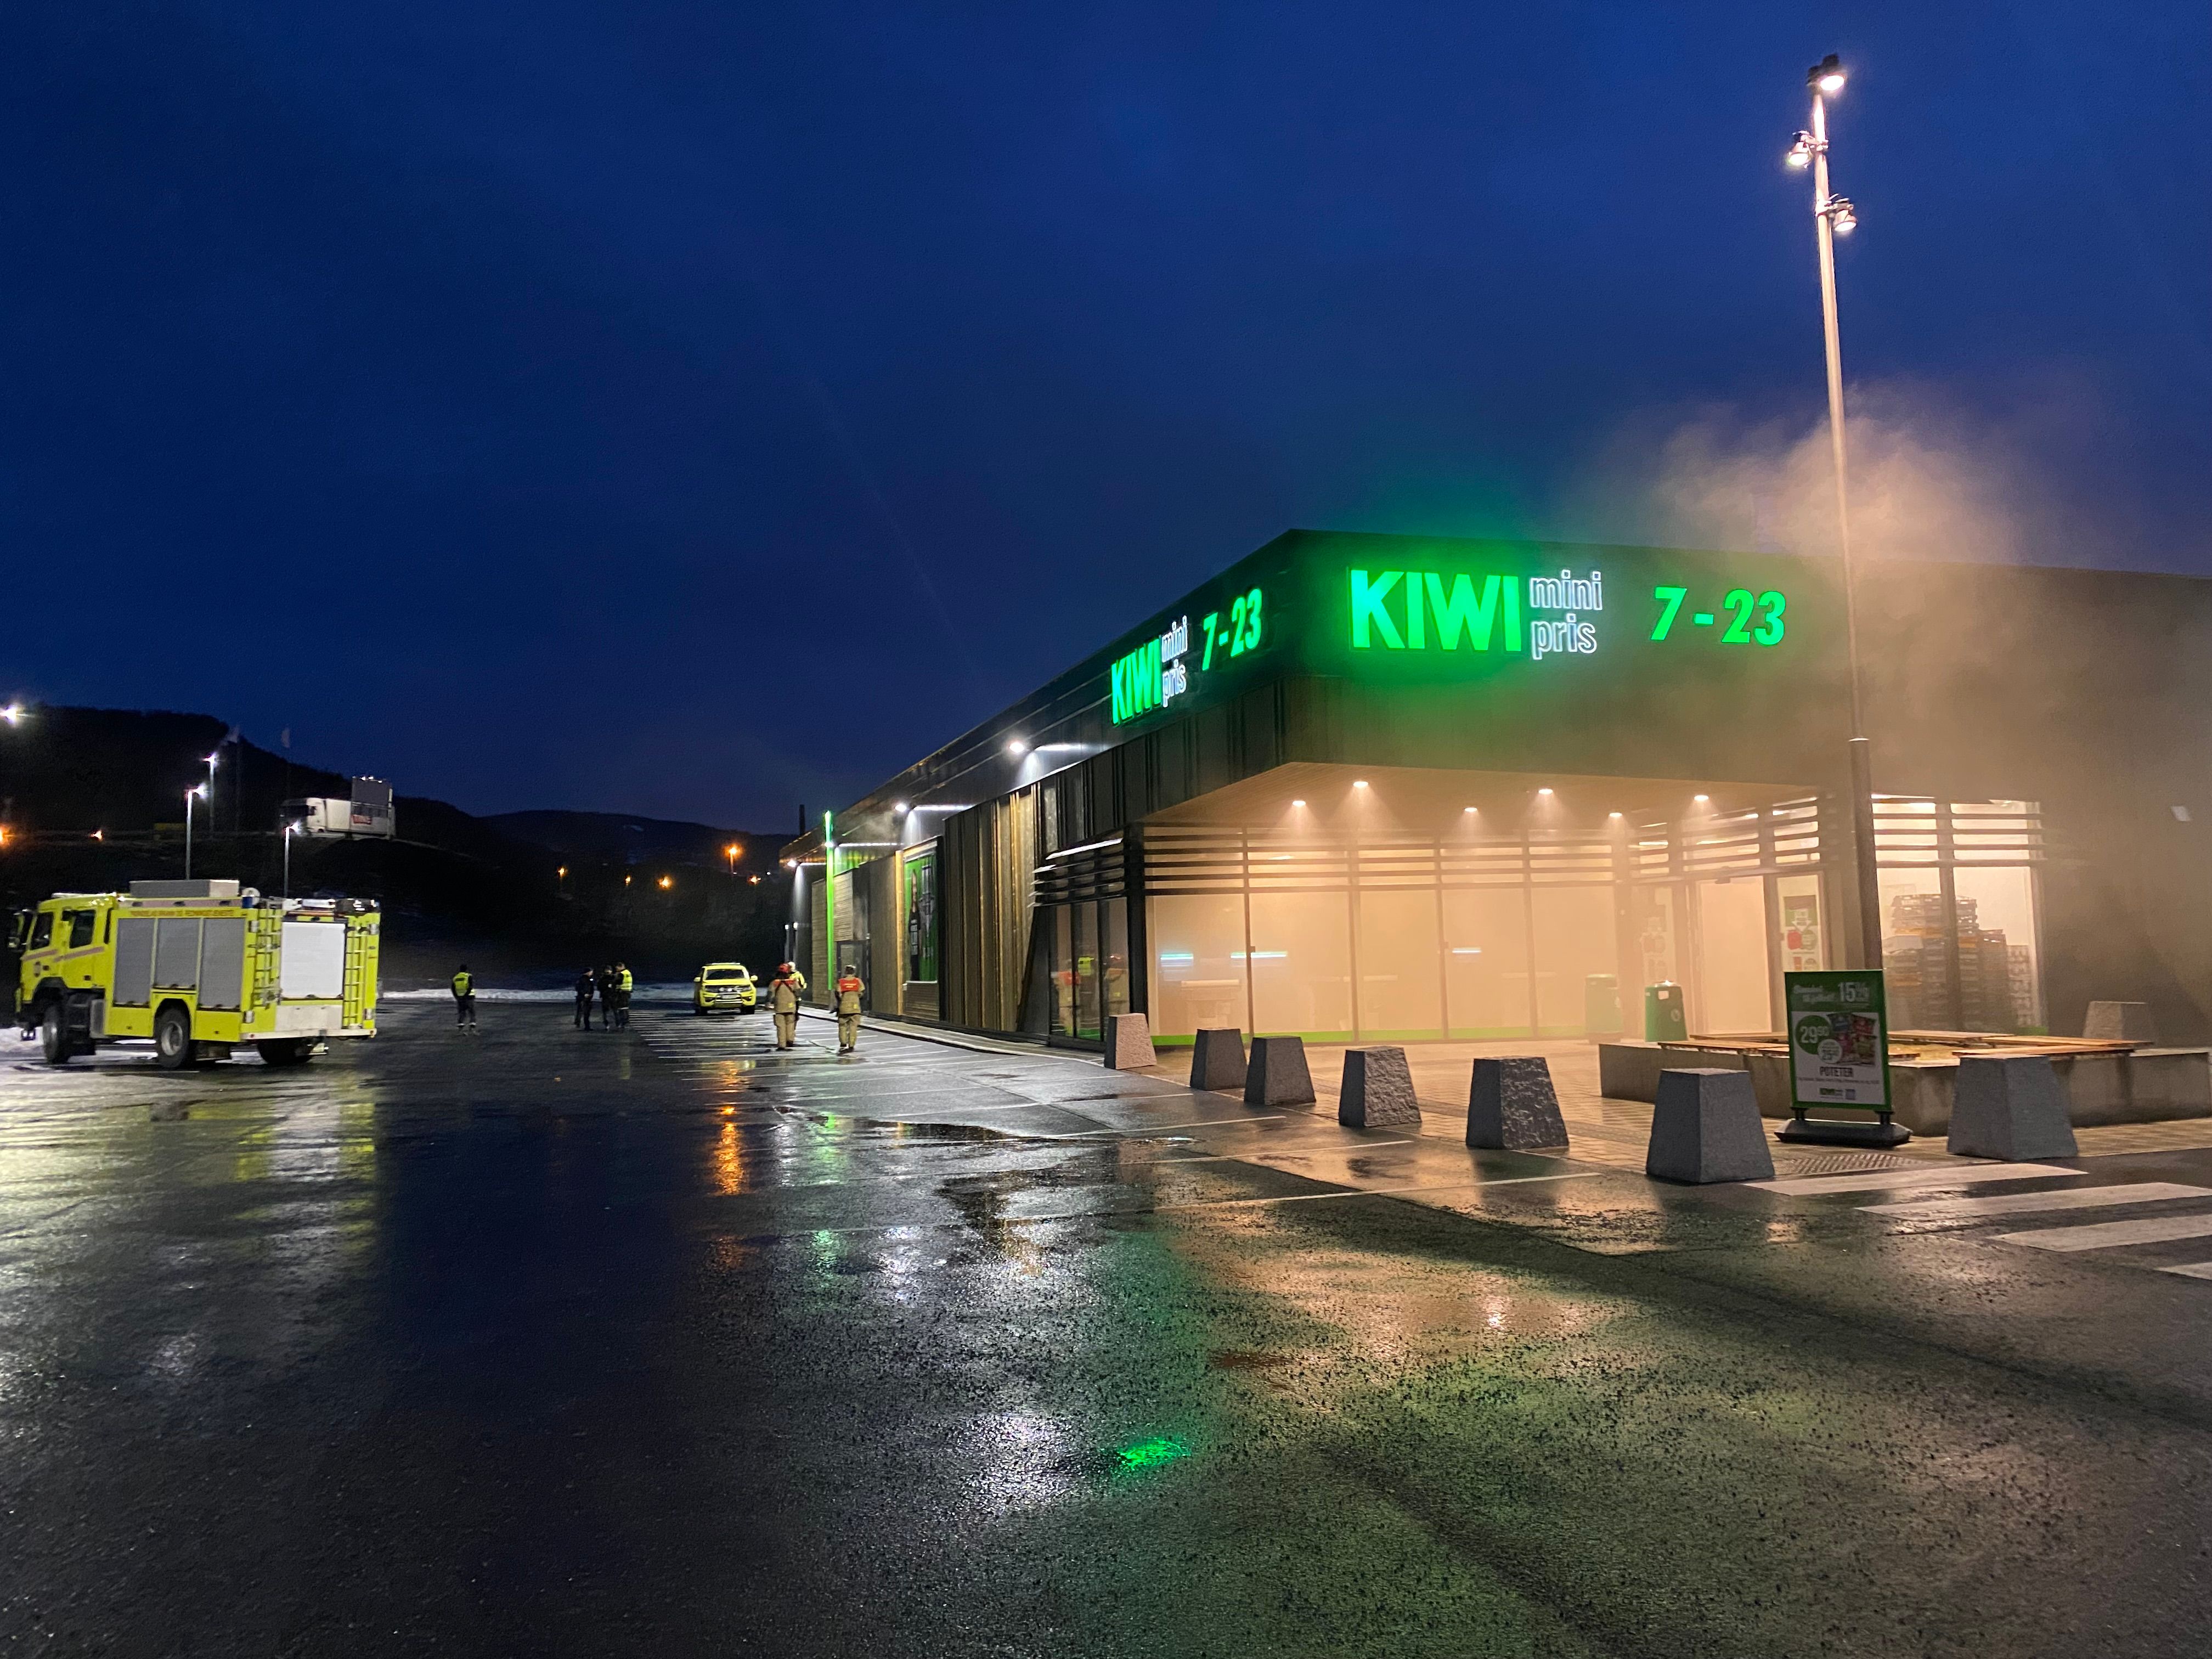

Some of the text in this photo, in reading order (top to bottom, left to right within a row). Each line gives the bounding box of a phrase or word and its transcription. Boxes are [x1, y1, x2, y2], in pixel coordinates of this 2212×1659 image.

[1351, 569, 1522, 651] KIWI
[1530, 570, 1602, 611] mini
[1161, 615, 1188, 663] mini
[1531, 613, 1597, 659] pris
[1111, 639, 1162, 725] KIWI
[1162, 659, 1186, 707] pris
